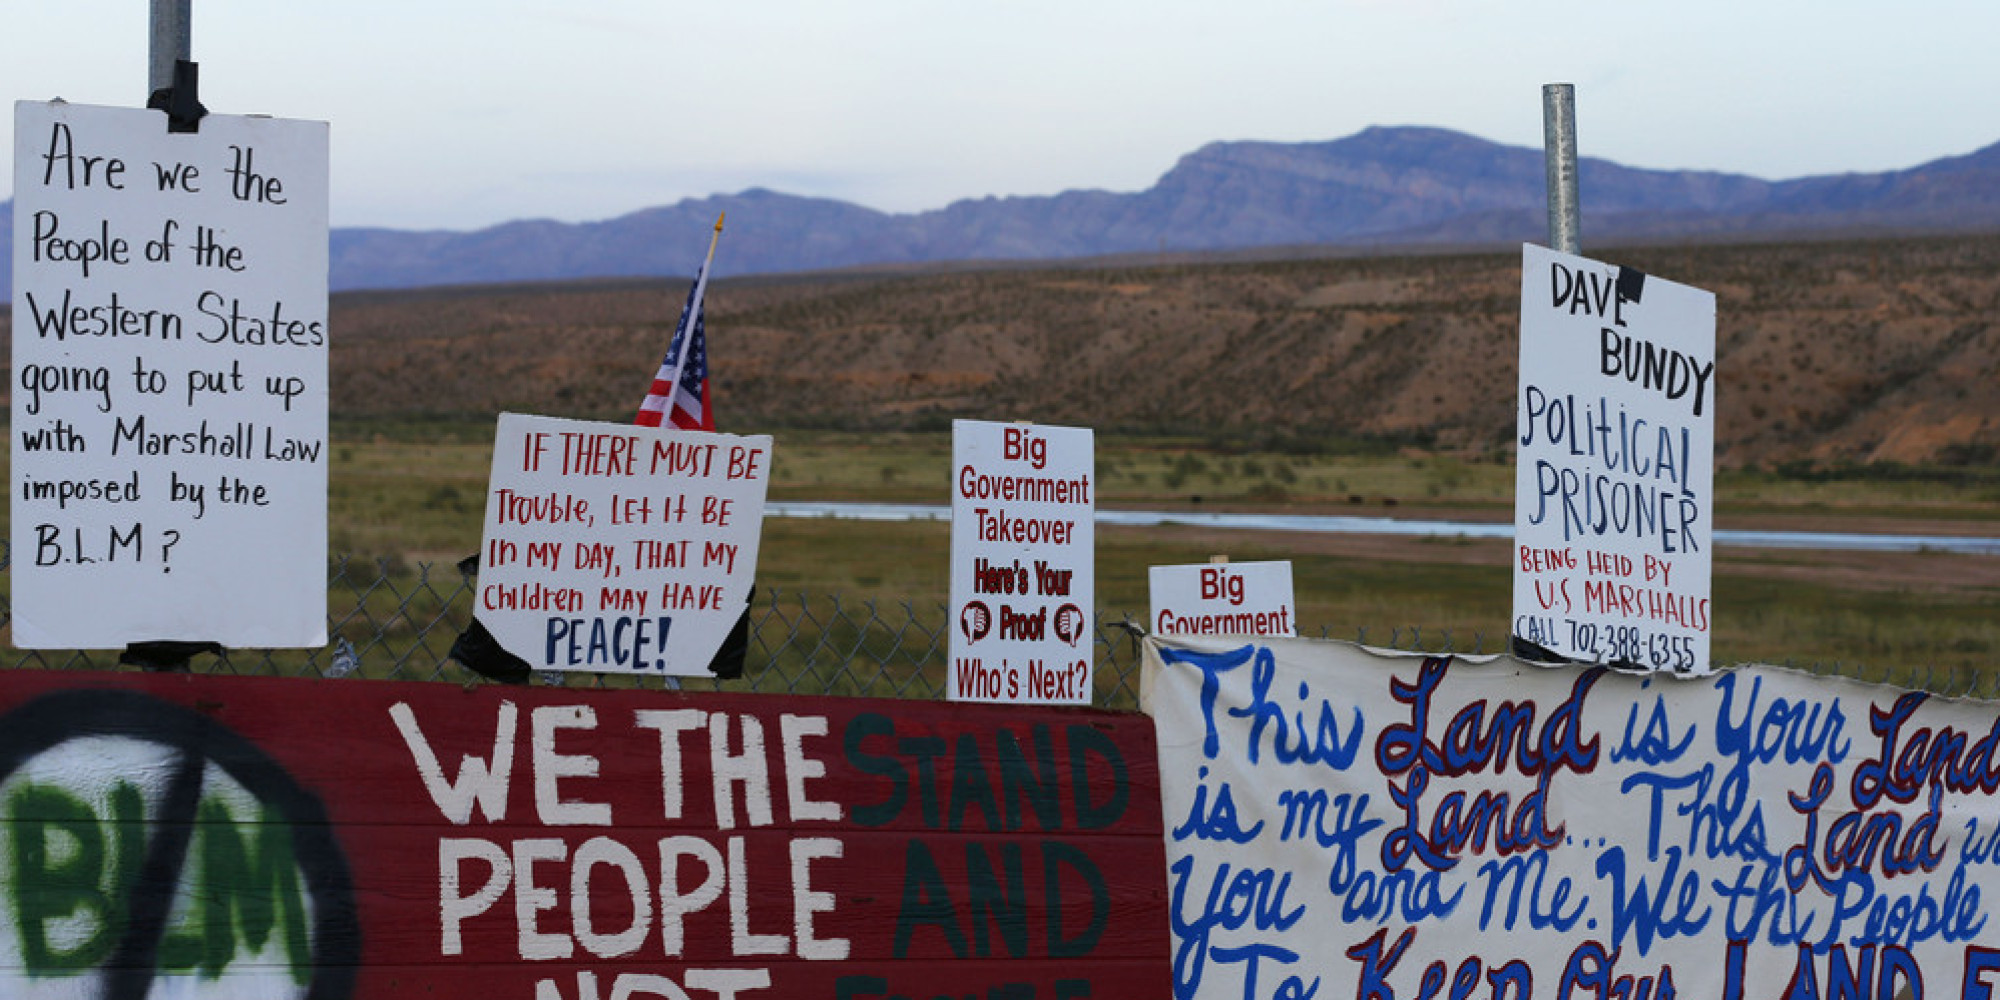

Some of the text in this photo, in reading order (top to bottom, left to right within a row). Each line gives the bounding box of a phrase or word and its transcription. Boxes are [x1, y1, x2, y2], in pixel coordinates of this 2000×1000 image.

[42, 122, 287, 205] Are we the
[32, 210, 246, 278] People of the
[25, 288, 324, 346] Western States
[1552, 262, 1627, 327] DAVE
[21, 356, 305, 415] going to put up
[1600, 327, 1714, 417] BUNDY
[22, 414, 321, 463] with Marshall Law
[523, 432, 763, 481] IF THERE MUST BE
[1003, 427, 1047, 469] Big
[23, 471, 270, 520] imposed by the
[959, 465, 1089, 504] Government
[701, 495, 735, 527] BE
[974, 508, 1075, 545] Takeover
[526, 541, 563, 572] MY
[574, 542, 621, 578] DAY,
[633, 540, 693, 570] THAT
[703, 540, 738, 575] MY
[973, 558, 1073, 596] Here's Your
[1520, 545, 1577, 574] BEING
[1644, 554, 1672, 587] BY
[600, 586, 648, 616] MAY
[662, 583, 724, 610] HAVE
[1200, 567, 1245, 606] Big
[1584, 580, 1709, 632] MARSHALLS
[546, 616, 672, 670] PEACE!
[999, 605, 1046, 641] Proof
[1157, 605, 1289, 635] Government
[1516, 615, 1695, 669] CALL 702-388-6355
[956, 658, 1087, 700] Who's Next?
[1158, 643, 2000, 828] This Land is Your Land
[389, 699, 1131, 833] WE THE STAND
[1172, 765, 1265, 844] is
[1278, 789, 1386, 897] my
[1620, 762, 1783, 862] This
[1783, 760, 1950, 896] Land
[5, 776, 314, 986] BLM
[438, 834, 1112, 961] PEOPLE AND
[1170, 853, 1306, 1000] You
[1341, 867, 1468, 925] and
[1596, 845, 1712, 958] We
[1812, 864, 1989, 954] People
